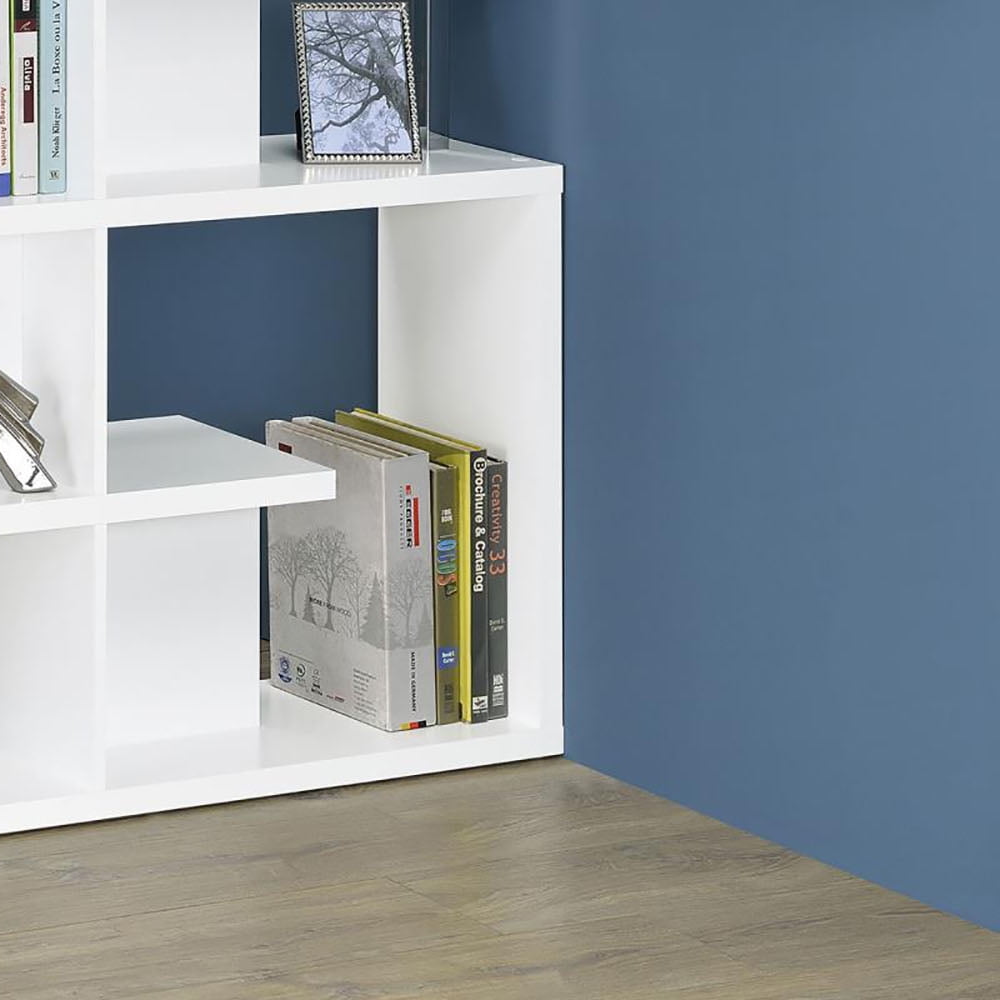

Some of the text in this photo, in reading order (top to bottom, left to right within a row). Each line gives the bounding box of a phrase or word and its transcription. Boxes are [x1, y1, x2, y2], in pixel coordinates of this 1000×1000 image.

[51, 12, 60, 24] la
[53, 26, 60, 42] ou
[51, 45, 60, 74] Boxe
[24, 59, 32, 92] olivia
[51, 78, 60, 94] La
[472, 457, 487, 592] Brochure & Catalog
[489, 474, 506, 576] Creativity 33
